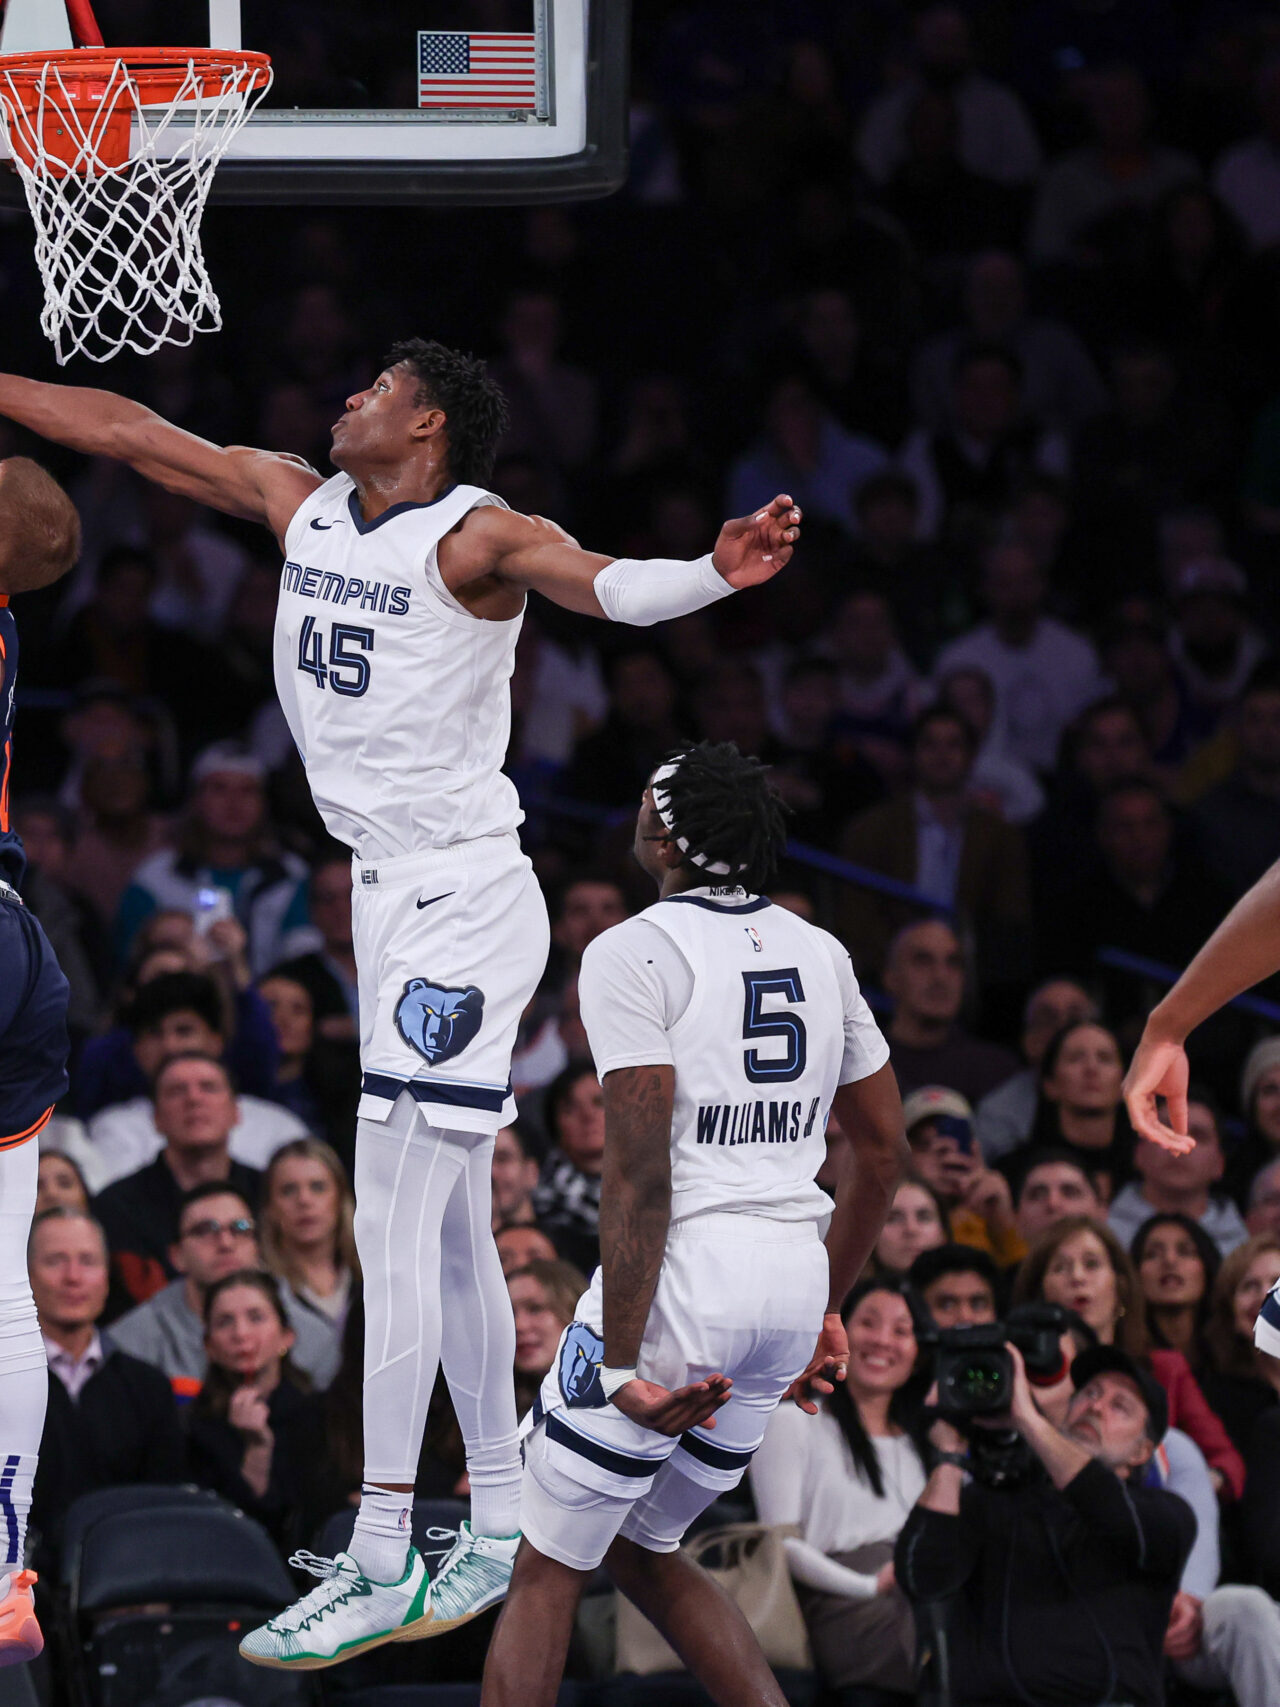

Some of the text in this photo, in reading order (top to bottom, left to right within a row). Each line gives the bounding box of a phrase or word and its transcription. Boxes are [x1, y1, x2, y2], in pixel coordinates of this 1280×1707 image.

[283, 561, 412, 616] MEMPHIS
[297, 615, 375, 698] 45
[741, 967, 807, 1084] 5
[696, 1100, 801, 1146] WILLIAMS
